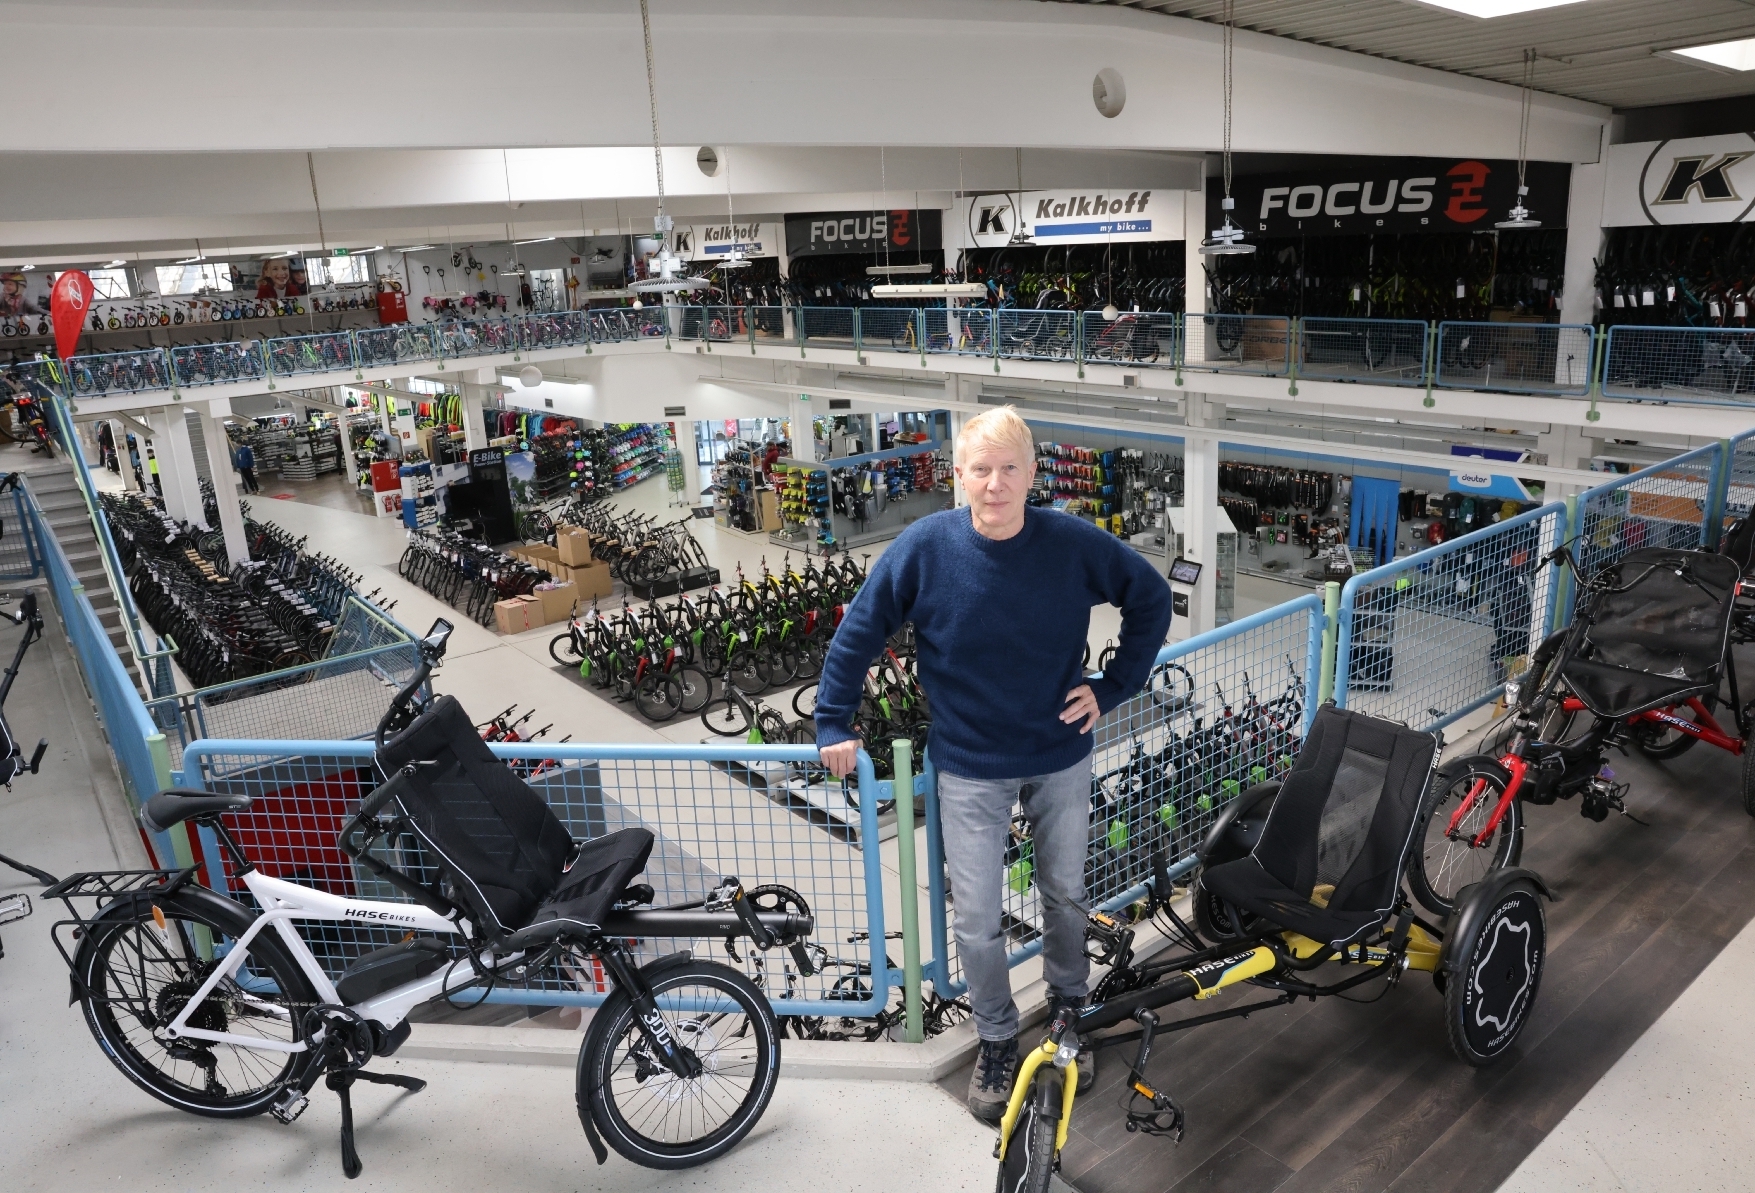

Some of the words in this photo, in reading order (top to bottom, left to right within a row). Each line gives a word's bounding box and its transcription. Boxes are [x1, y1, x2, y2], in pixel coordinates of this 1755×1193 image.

[1652, 150, 1755, 206] K
[1035, 191, 1152, 219] Kalkhoff
[1260, 177, 1437, 219] FOCUS
[811, 215, 887, 243] FOCUS
[975, 205, 1011, 236] K
[1099, 225, 1113, 234] my
[675, 231, 692, 254] K
[704, 223, 760, 242] Kalkhoff
[473, 451, 501, 463] E-Bike
[1461, 473, 1488, 483] deuter
[344, 908, 389, 920] HASE
[389, 915, 416, 923] BIKES
[1189, 956, 1236, 976] HASE
